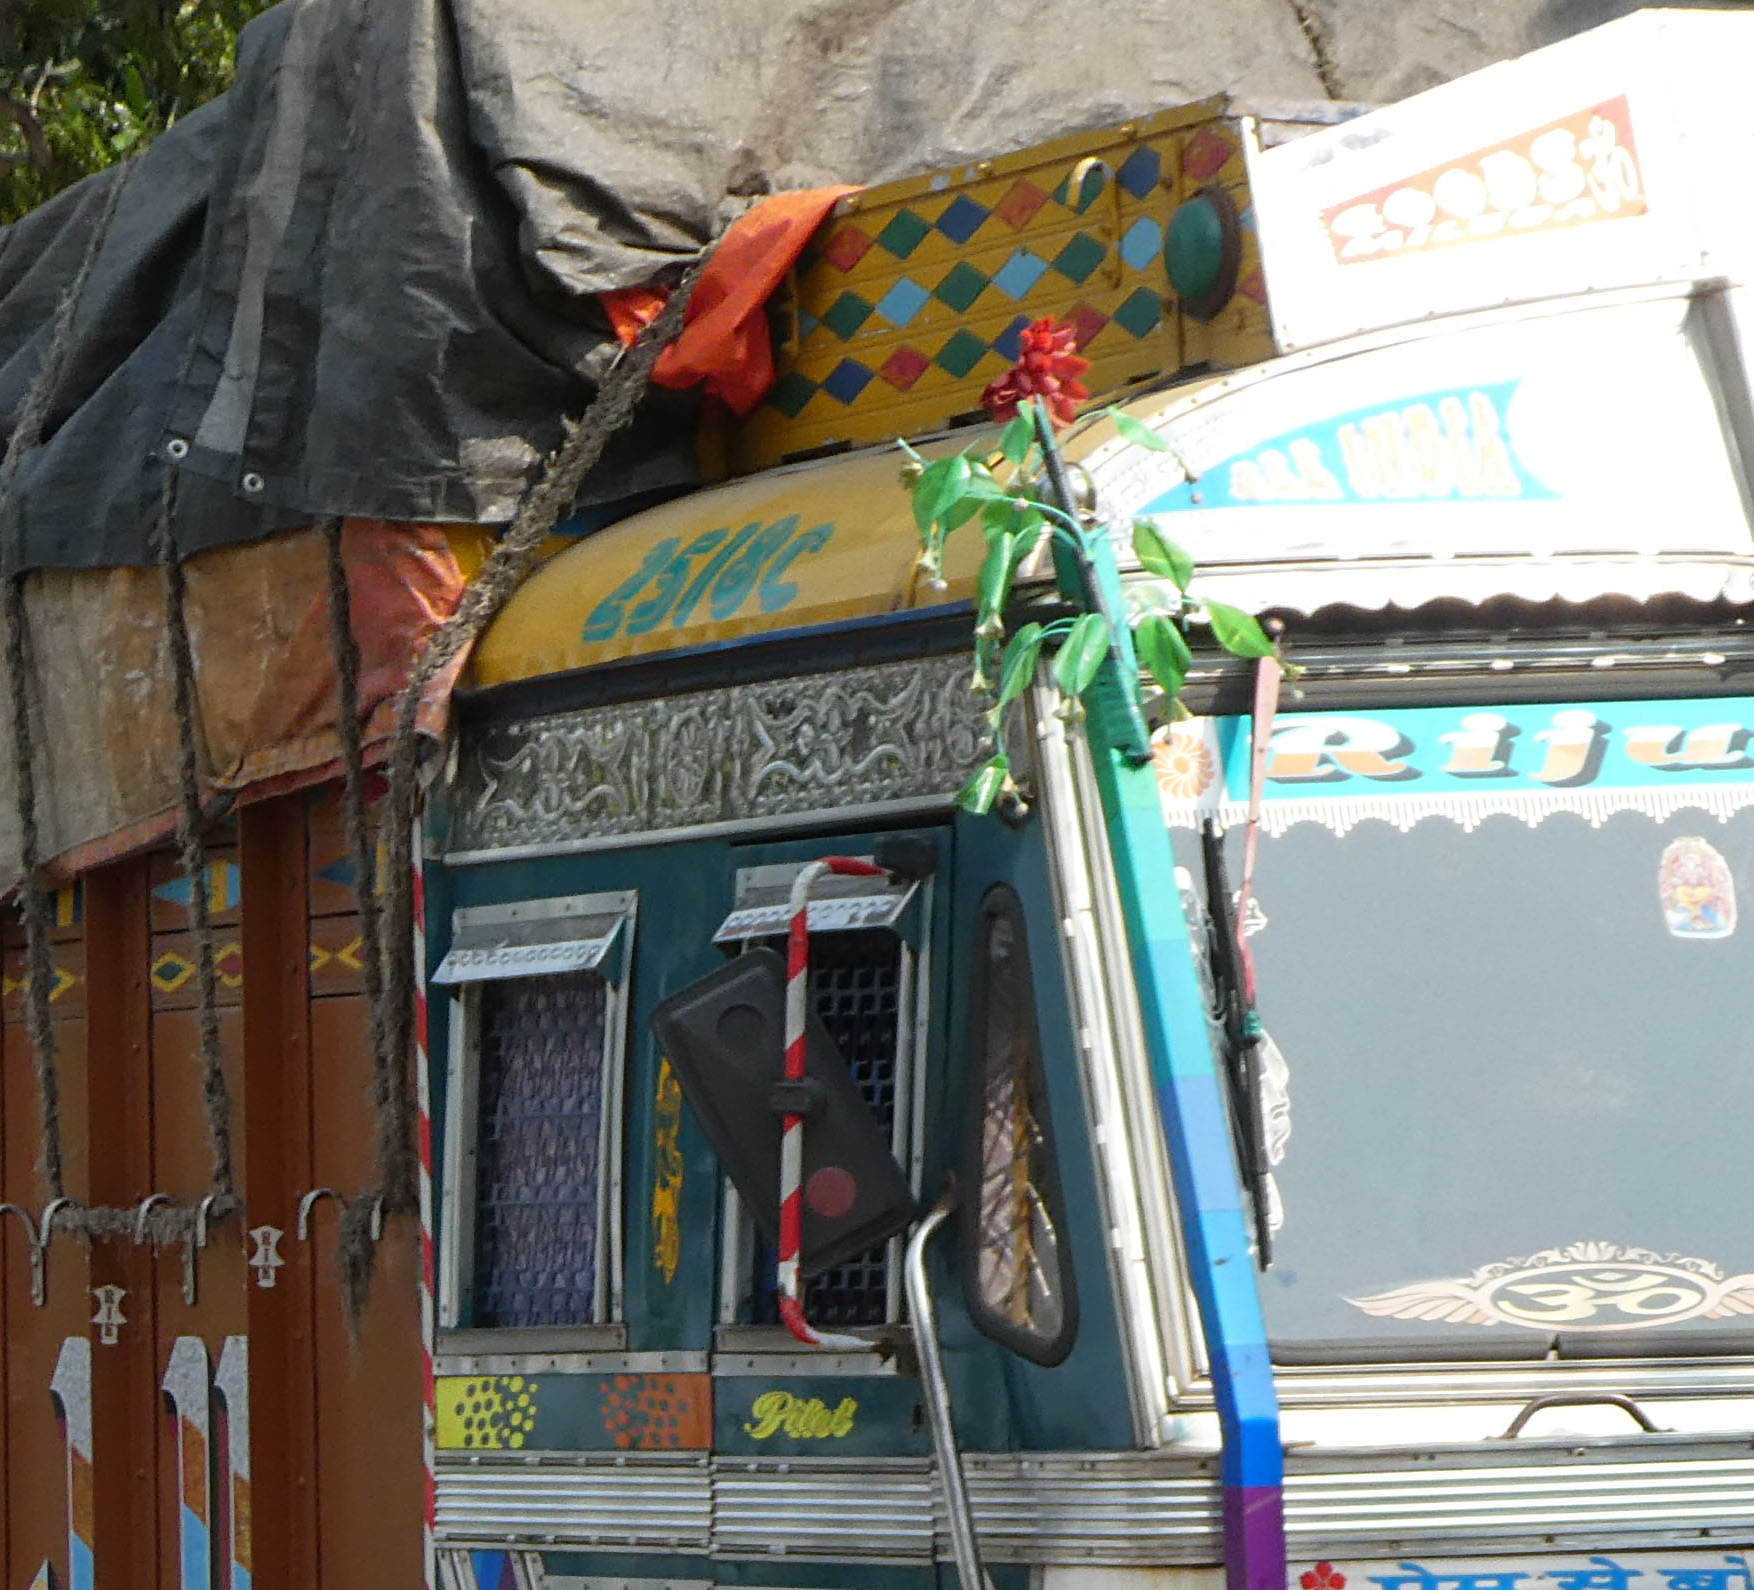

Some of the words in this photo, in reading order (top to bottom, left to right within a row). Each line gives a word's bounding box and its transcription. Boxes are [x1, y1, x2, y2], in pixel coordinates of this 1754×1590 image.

[1229, 437, 1343, 502] ALL
[1337, 390, 1522, 500] INDIA
[582, 513, 837, 643] 2518C
[1249, 709, 1754, 788] Riju
